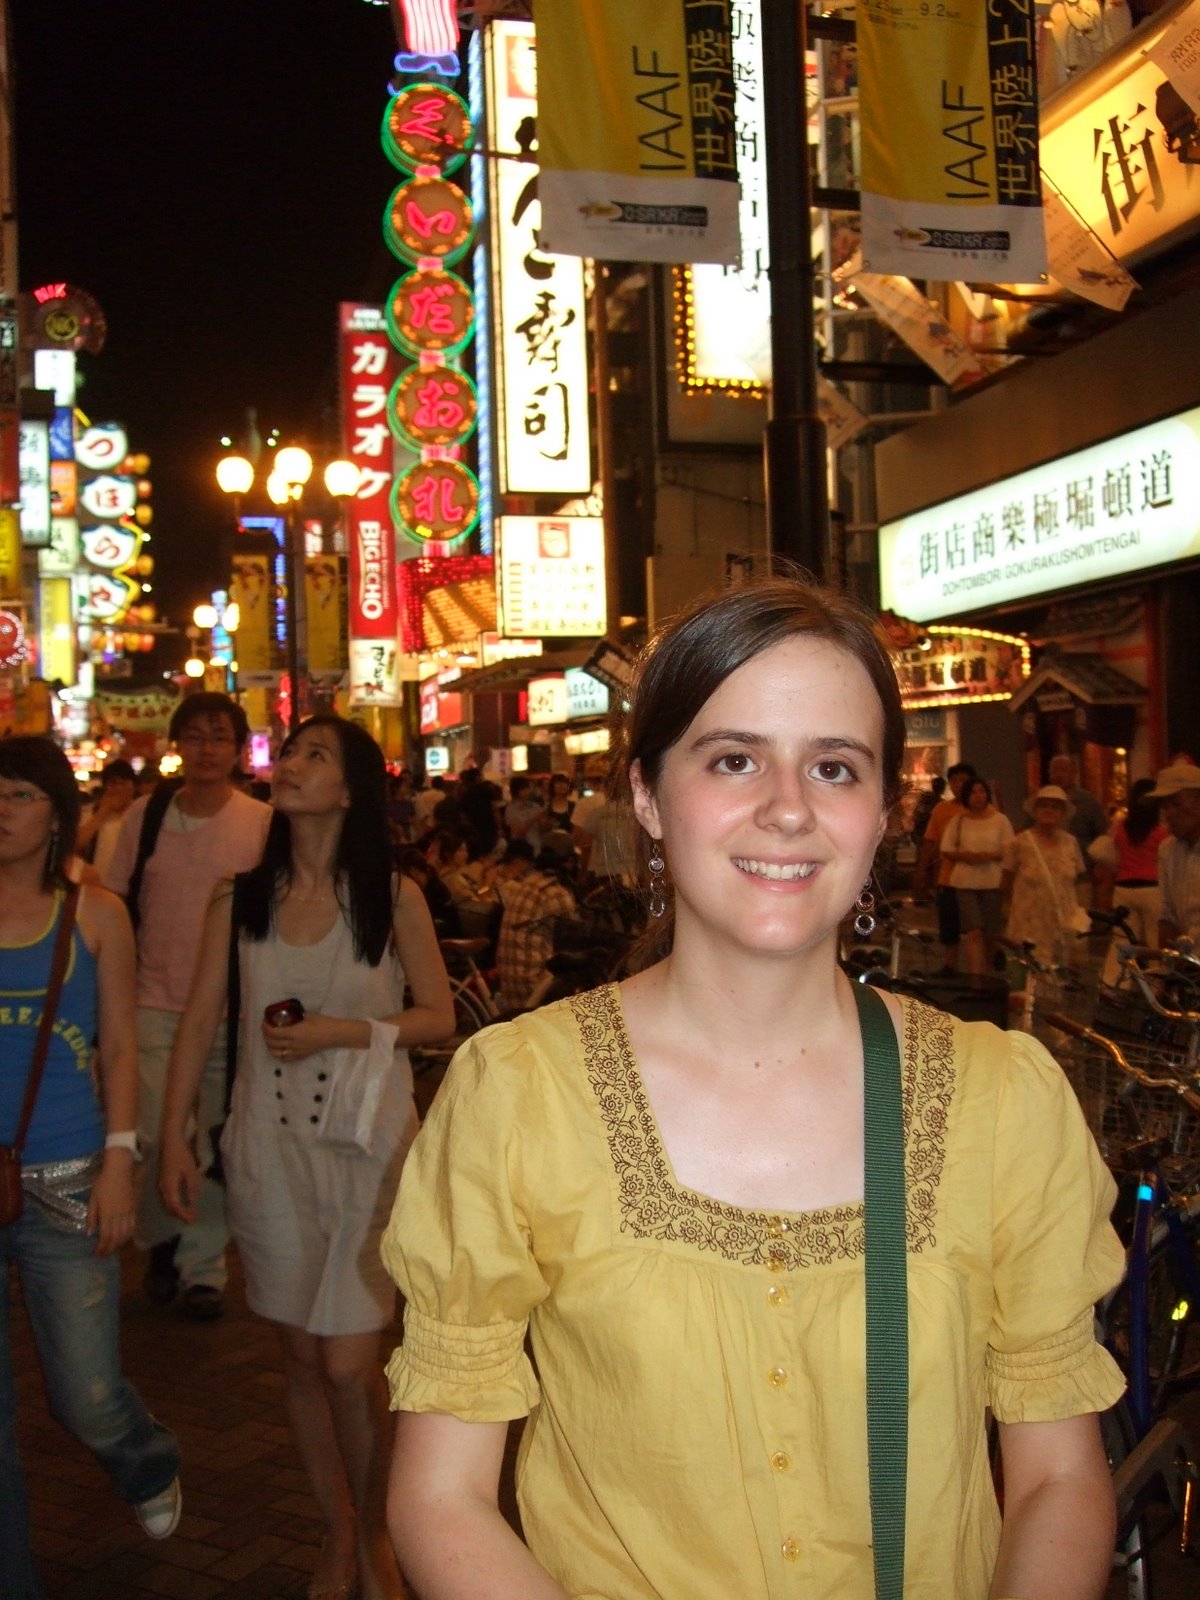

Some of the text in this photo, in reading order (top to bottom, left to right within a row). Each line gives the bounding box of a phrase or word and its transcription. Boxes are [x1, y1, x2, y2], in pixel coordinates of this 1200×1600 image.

[633, 45, 686, 170] IAAF
[941, 79, 991, 200] IAAF
[400, 97, 464, 523] くいだおれ
[351, 341, 391, 500] カラオケ
[358, 520, 382, 560] BIG
[360, 562, 384, 620] ECHO
[942, 568, 1002, 597] DOHTOMBORI
[1004, 528, 1141, 580] GOKURAKUSHOWTENGAI
